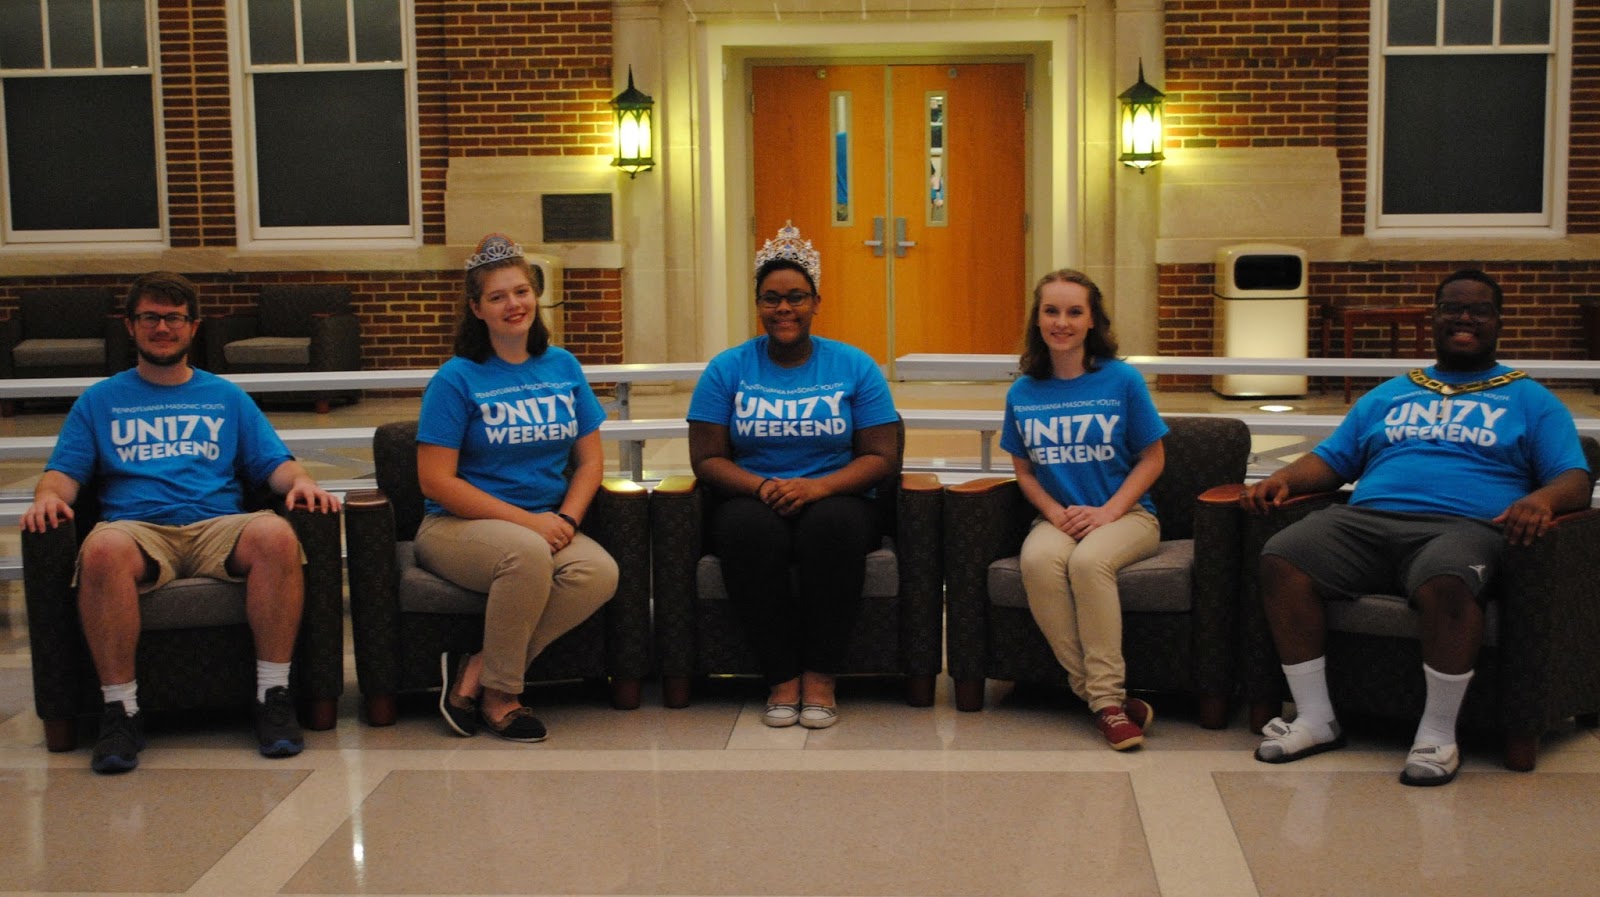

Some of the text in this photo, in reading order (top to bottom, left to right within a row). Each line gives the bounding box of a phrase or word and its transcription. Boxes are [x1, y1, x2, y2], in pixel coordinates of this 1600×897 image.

[740, 380, 786, 395] PNNSYLVANIA
[821, 382, 844, 390] YOUTH
[112, 403, 225, 414] PENNSYLVANIA MASONIC YOUTH
[480, 390, 576, 426] UN17Y
[735, 391, 845, 419] UN17Y
[1014, 399, 1121, 413] PENNSYLVANIA MASONIC YOUTH
[1384, 399, 1507, 429] UN17Y
[111, 415, 225, 446] UN17Y
[485, 419, 578, 444] WEEKEND
[735, 417, 847, 437] WEEKEND
[1016, 414, 1120, 447] UN17Y
[1384, 423, 1498, 447] WEEKEND
[116, 440, 220, 463] WEEKEND
